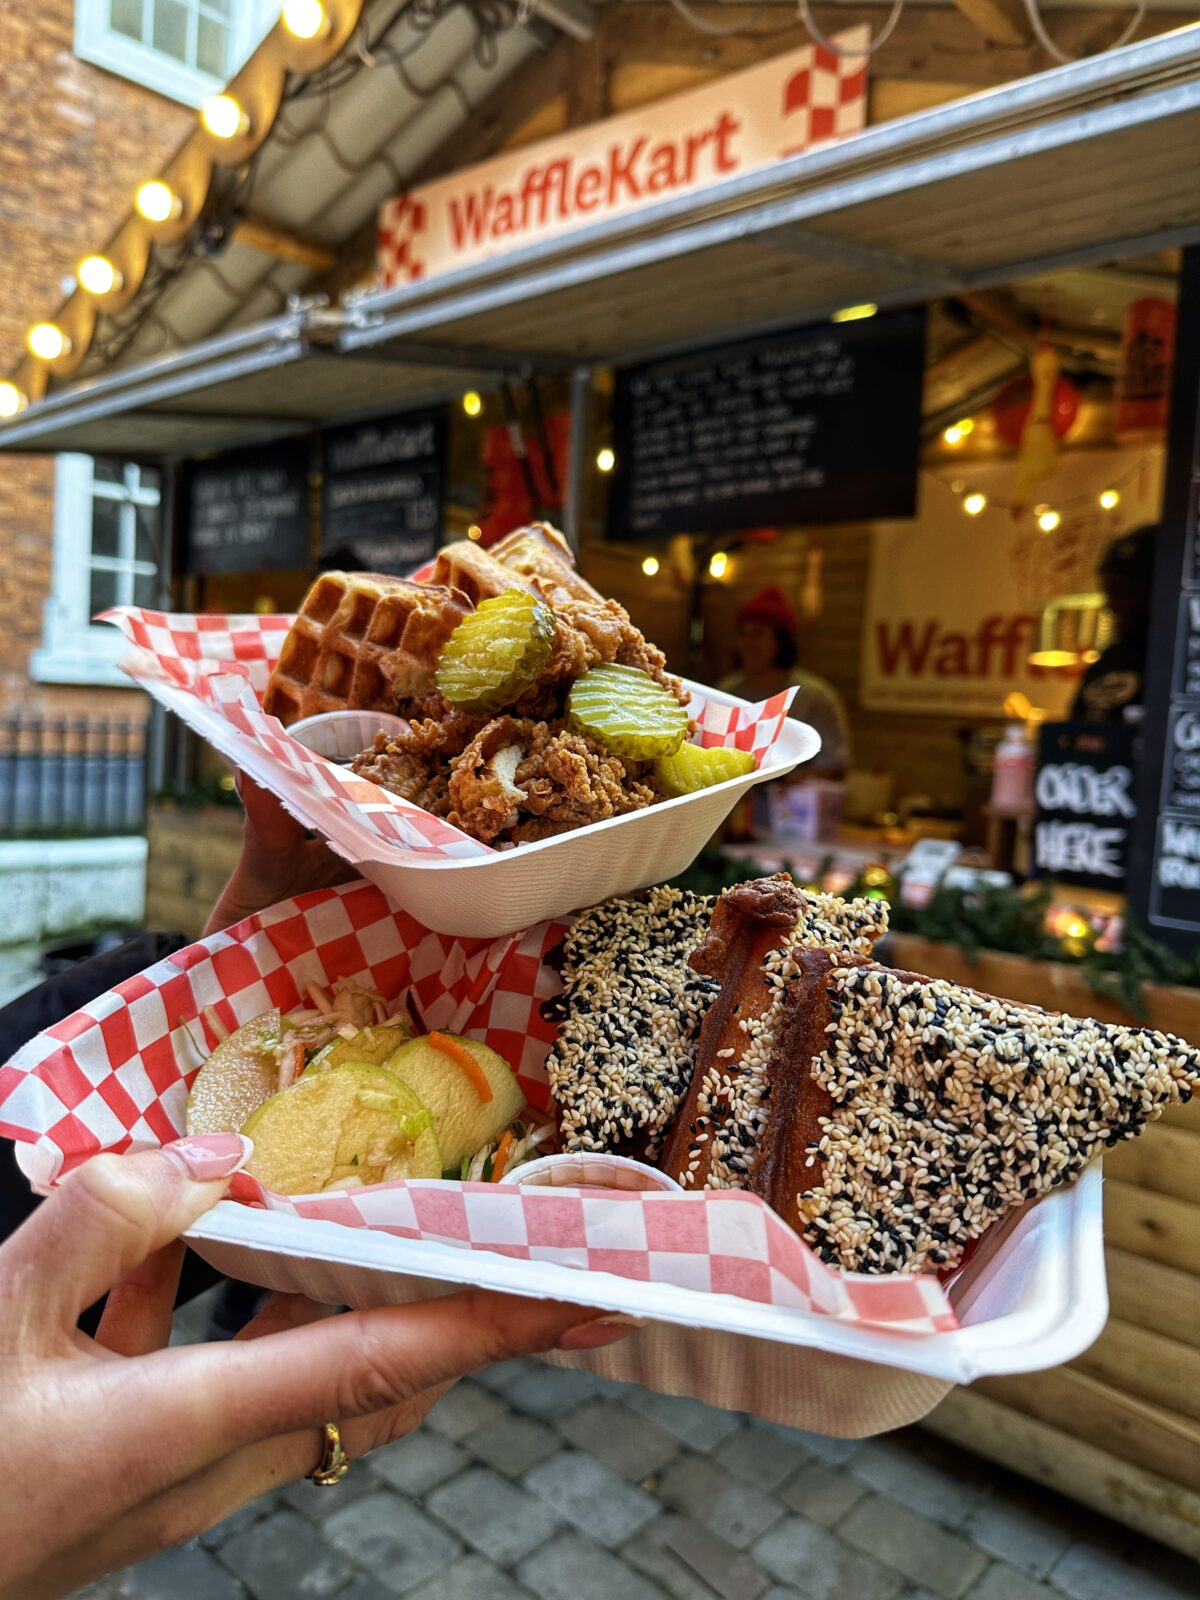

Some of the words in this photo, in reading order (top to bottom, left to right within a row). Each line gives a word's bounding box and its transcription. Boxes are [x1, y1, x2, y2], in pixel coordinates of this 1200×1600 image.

[449, 110, 741, 251] WaffleKart
[1036, 762, 1137, 818] ORDER
[1035, 819, 1127, 878] HERE
